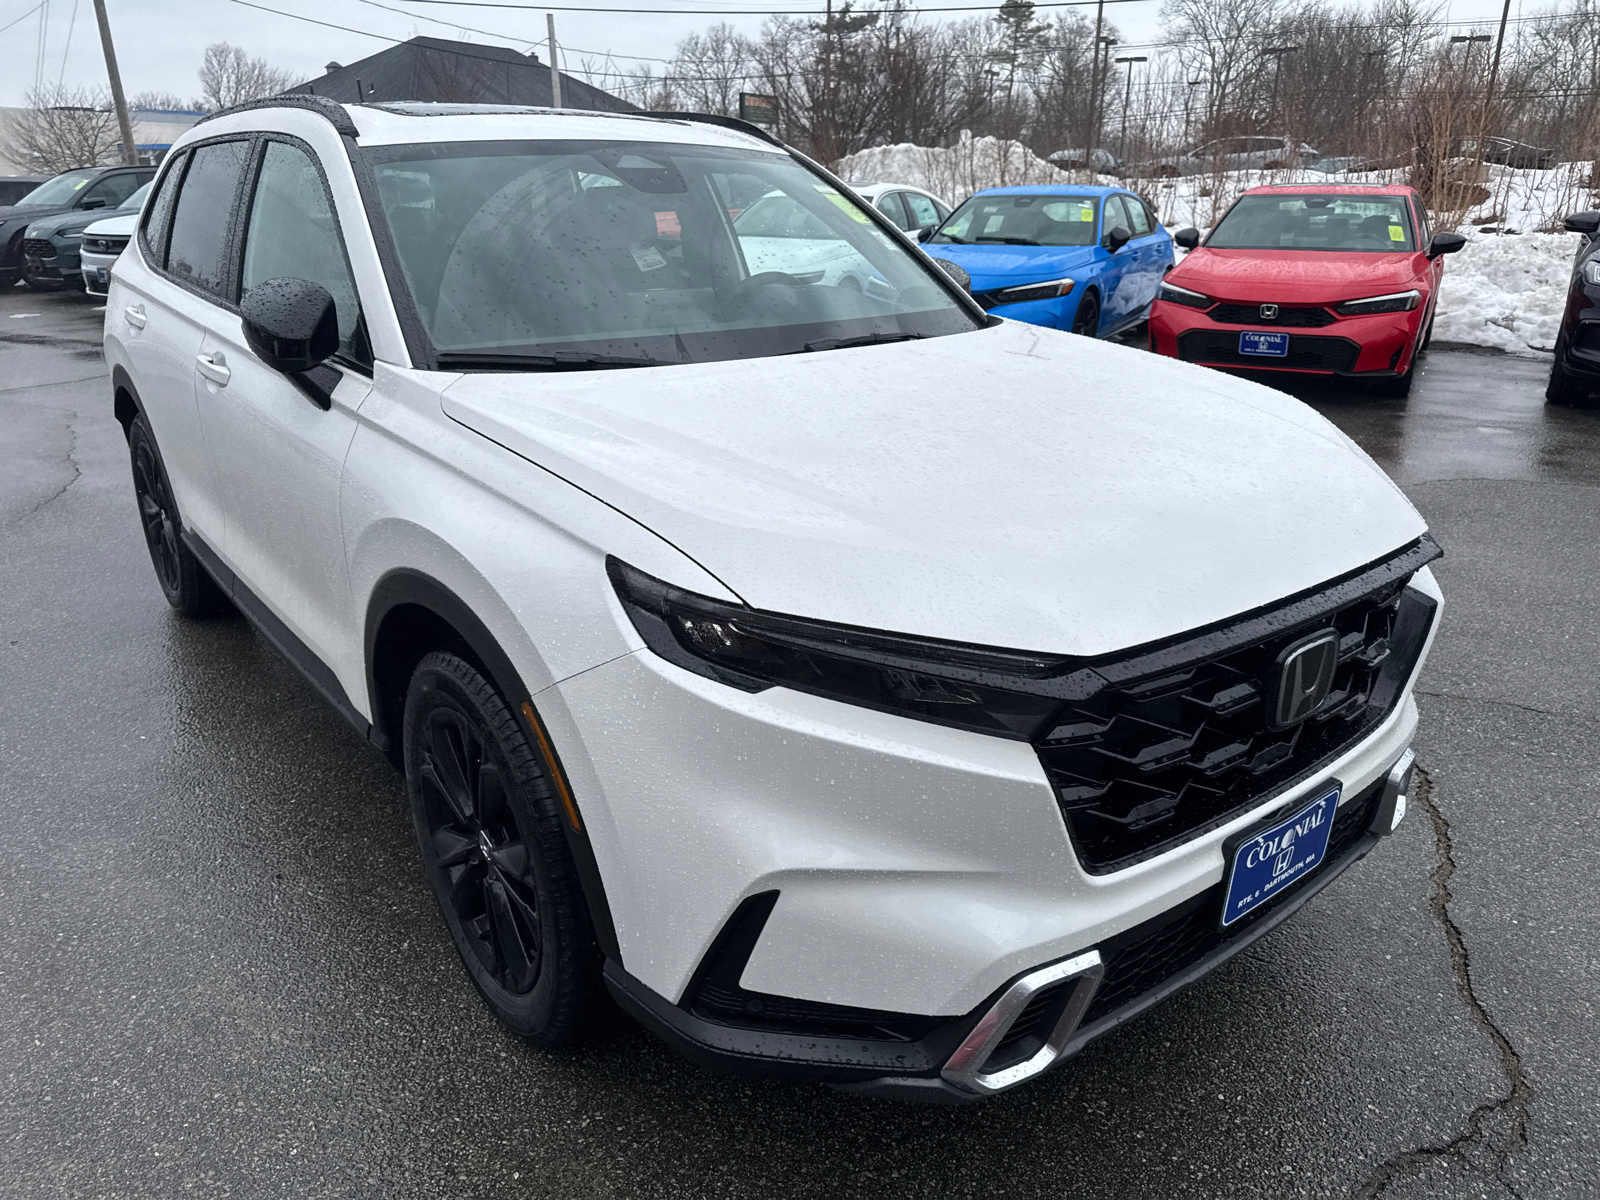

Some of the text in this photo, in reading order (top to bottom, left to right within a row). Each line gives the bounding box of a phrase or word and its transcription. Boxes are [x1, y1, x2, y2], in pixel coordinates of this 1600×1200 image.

[1246, 808, 1326, 868] COLONIAL
[1254, 890, 1260, 898] 6
[1305, 853, 1315, 864] MA
